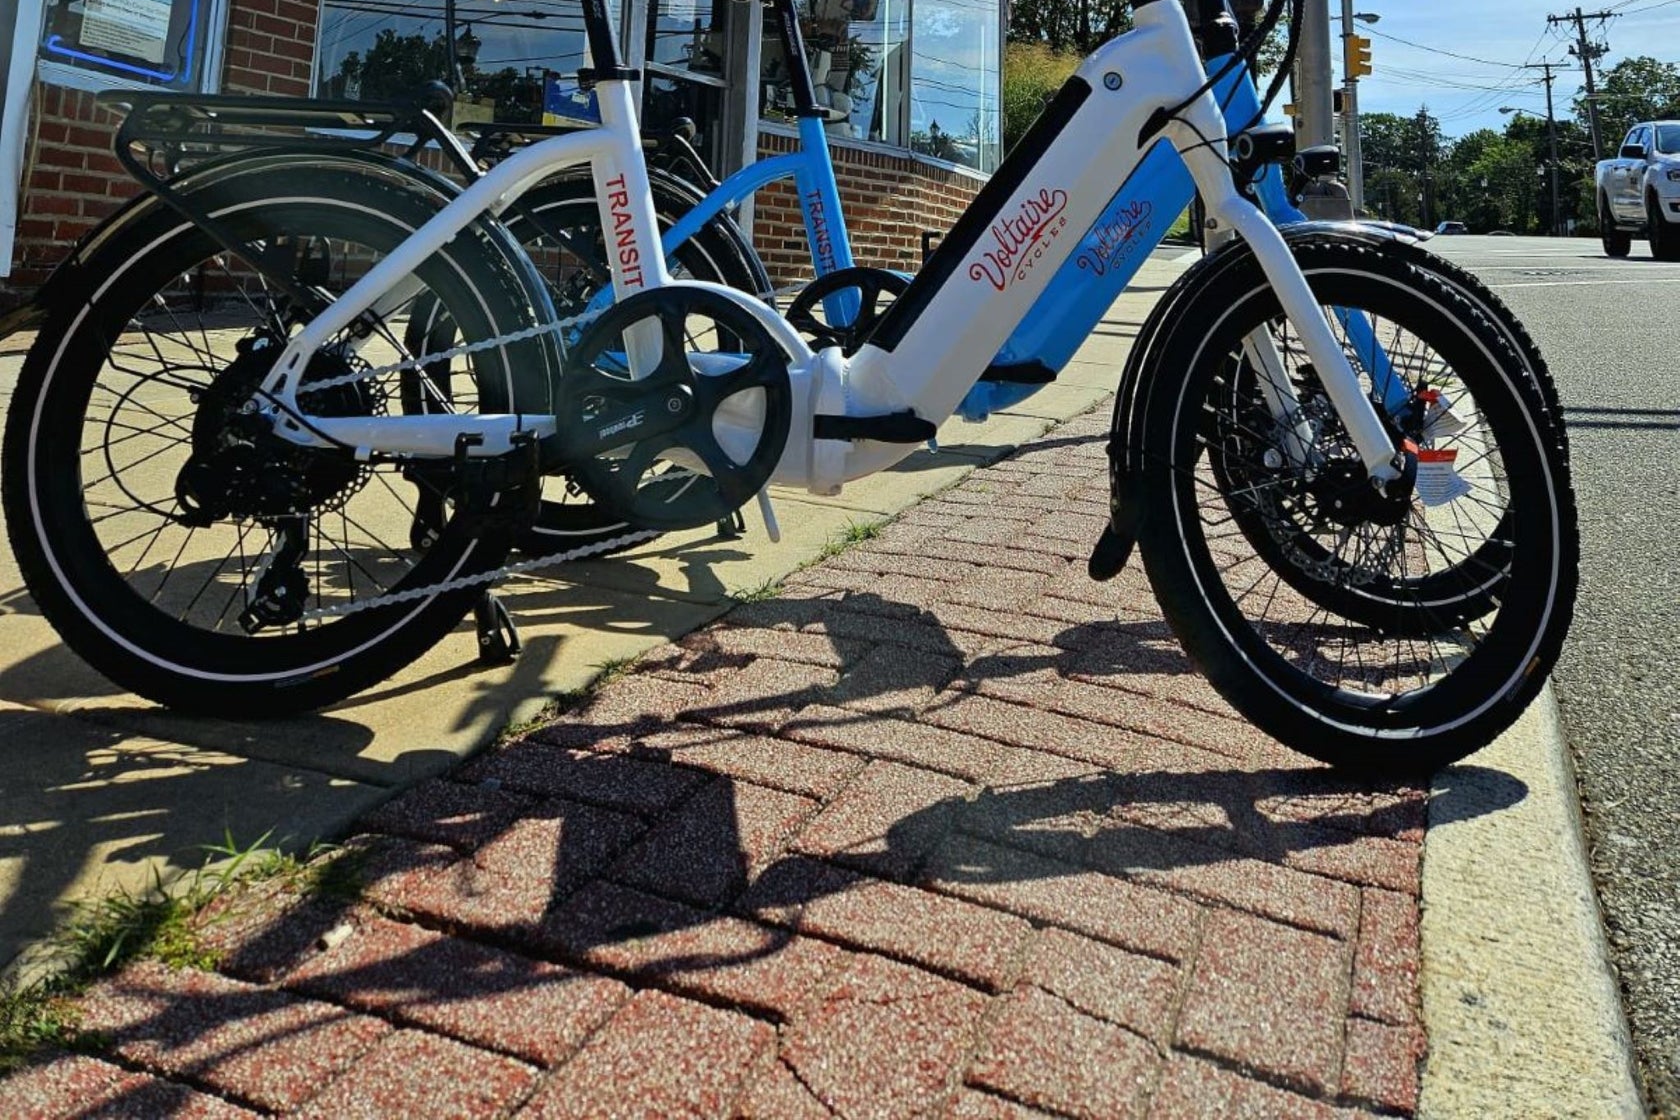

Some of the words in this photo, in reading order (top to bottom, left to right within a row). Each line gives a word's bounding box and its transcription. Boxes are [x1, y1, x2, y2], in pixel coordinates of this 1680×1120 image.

[605, 173, 645, 289] TRANSIT
[806, 188, 837, 273] TRANSIT
[969, 188, 1067, 291] Voltaire
[1018, 216, 1067, 280] CYCLES
[1076, 200, 1152, 276] Voltaire
